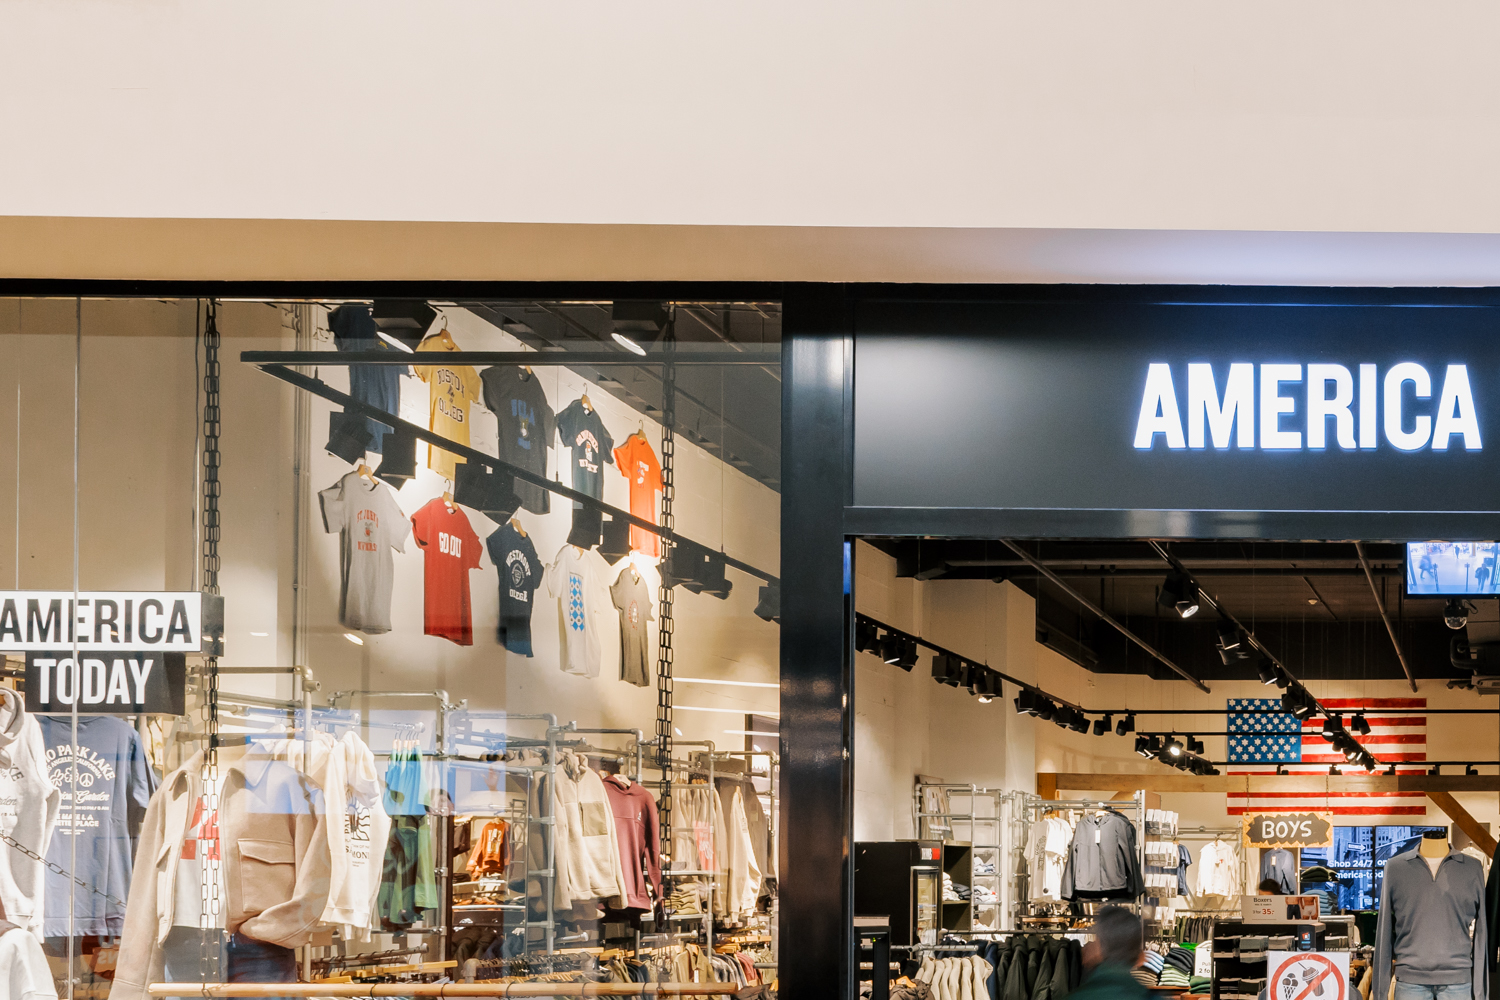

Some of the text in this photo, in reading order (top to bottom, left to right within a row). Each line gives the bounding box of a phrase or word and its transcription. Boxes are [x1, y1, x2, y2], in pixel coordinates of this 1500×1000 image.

[1133, 362, 1483, 451] AMERICA
[0, 598, 192, 644] AMERICA
[33, 658, 154, 705] TODAY
[90, 751, 116, 781] LAKE
[1262, 820, 1312, 839] BOYS
[1329, 859, 1350, 869] Shop
[1352, 859, 1373, 868] 24/7
